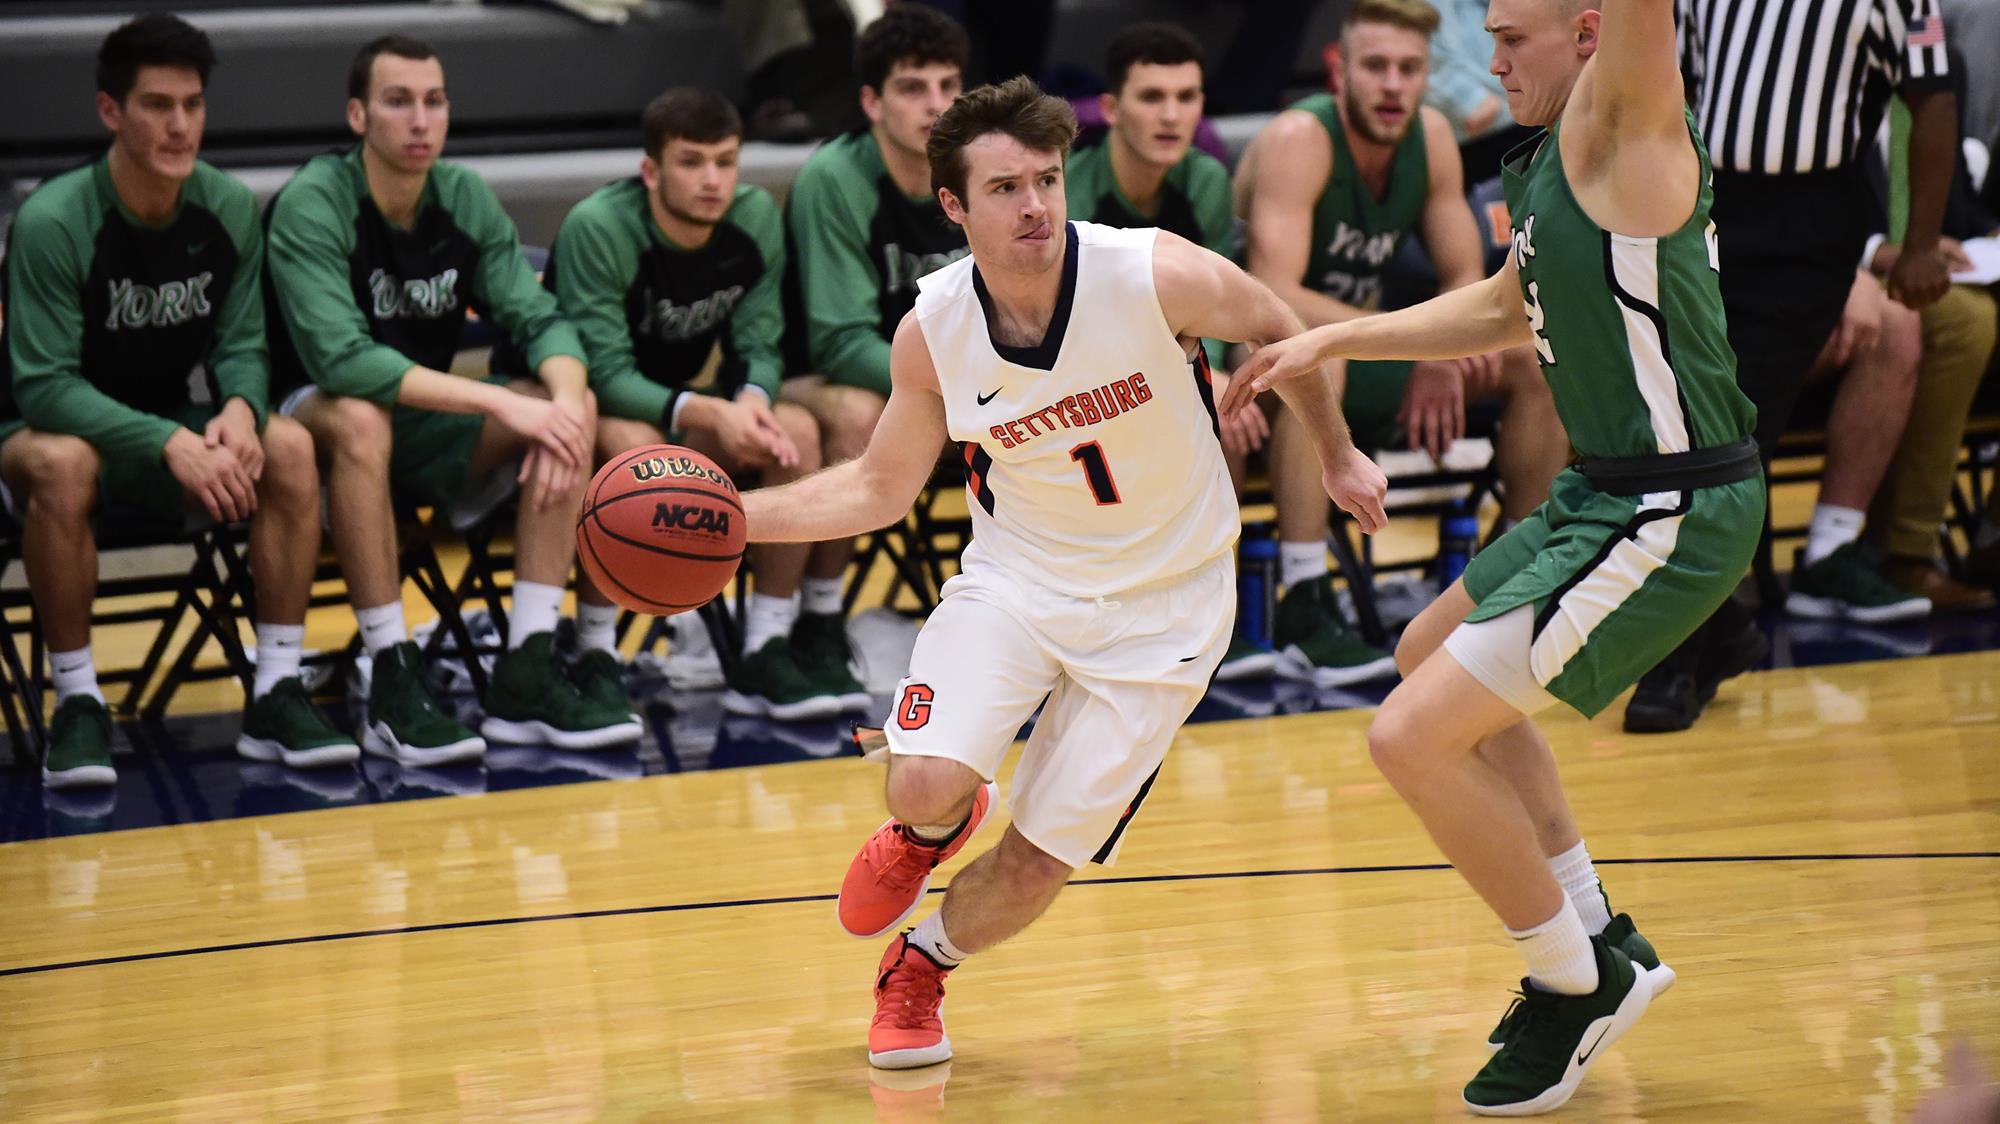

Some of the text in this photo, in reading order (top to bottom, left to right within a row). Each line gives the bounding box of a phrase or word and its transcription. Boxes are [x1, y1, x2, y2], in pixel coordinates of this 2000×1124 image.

[105, 271, 212, 330] YORK
[990, 372, 1153, 449] GETTYSBURG
[630, 456, 735, 494] Wilson
[1069, 440, 1122, 506] 1
[652, 502, 729, 536] NCAA
[897, 684, 934, 730] G
